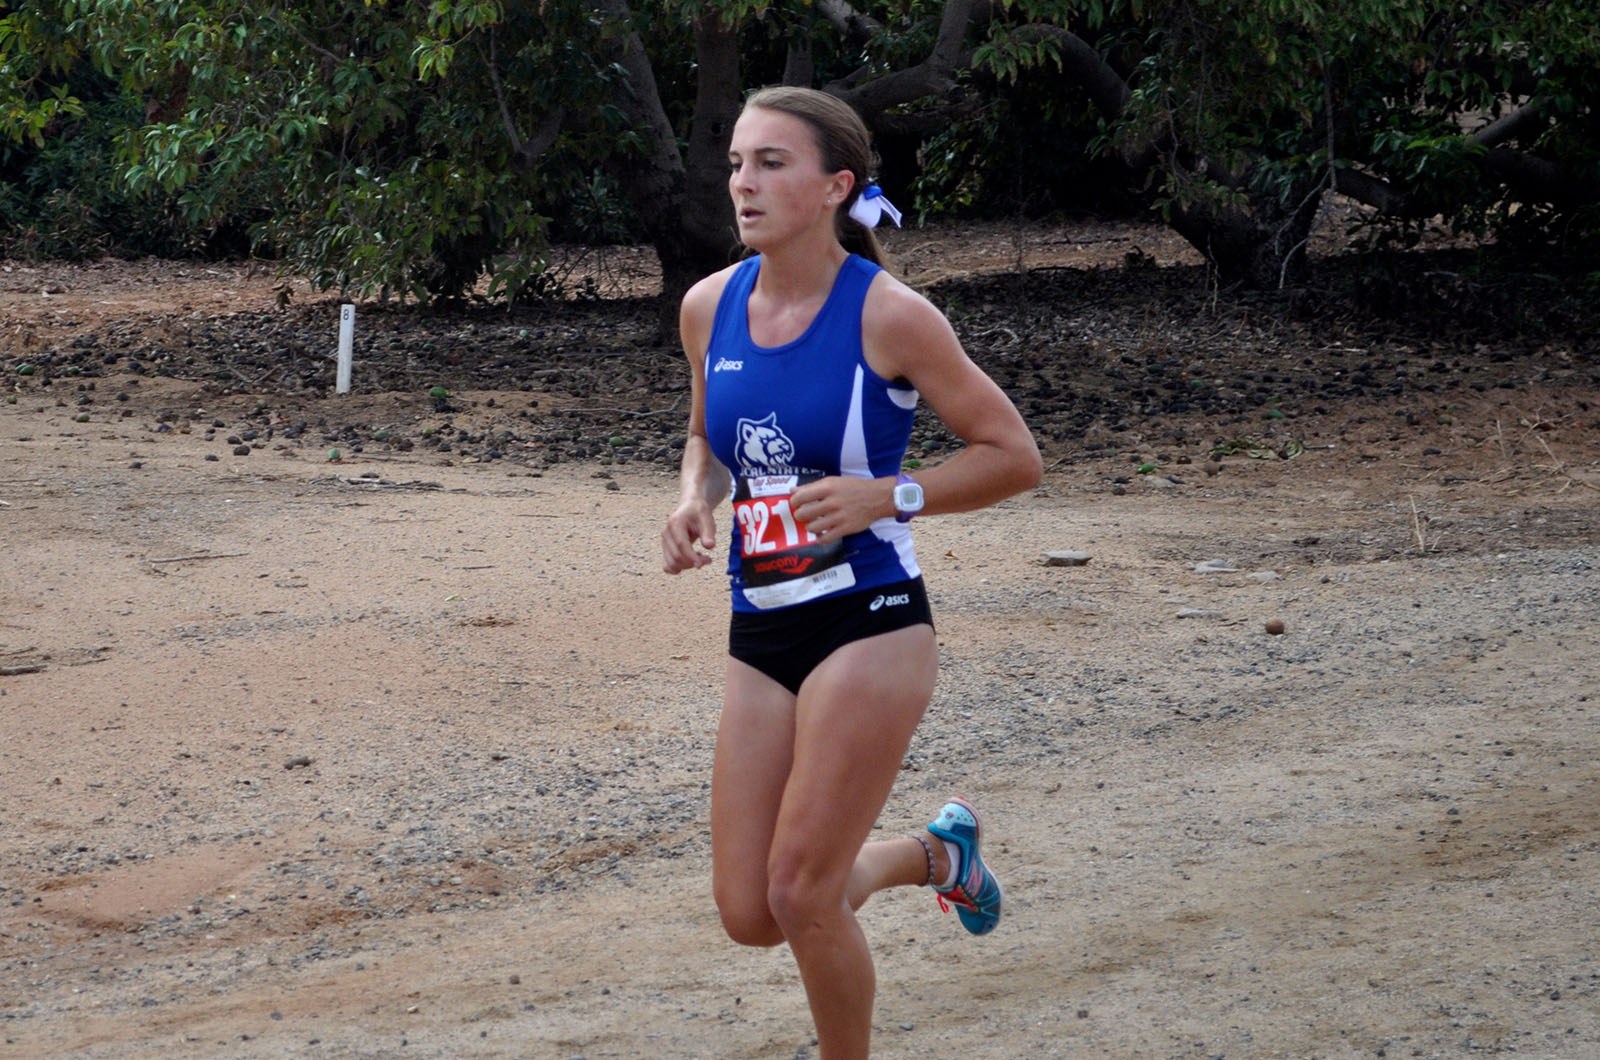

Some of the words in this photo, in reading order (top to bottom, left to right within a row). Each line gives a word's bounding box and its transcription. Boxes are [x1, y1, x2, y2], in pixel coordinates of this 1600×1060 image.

[343, 308, 349, 321] 8
[737, 499, 818, 555] 321
[885, 593, 910, 607] asics
